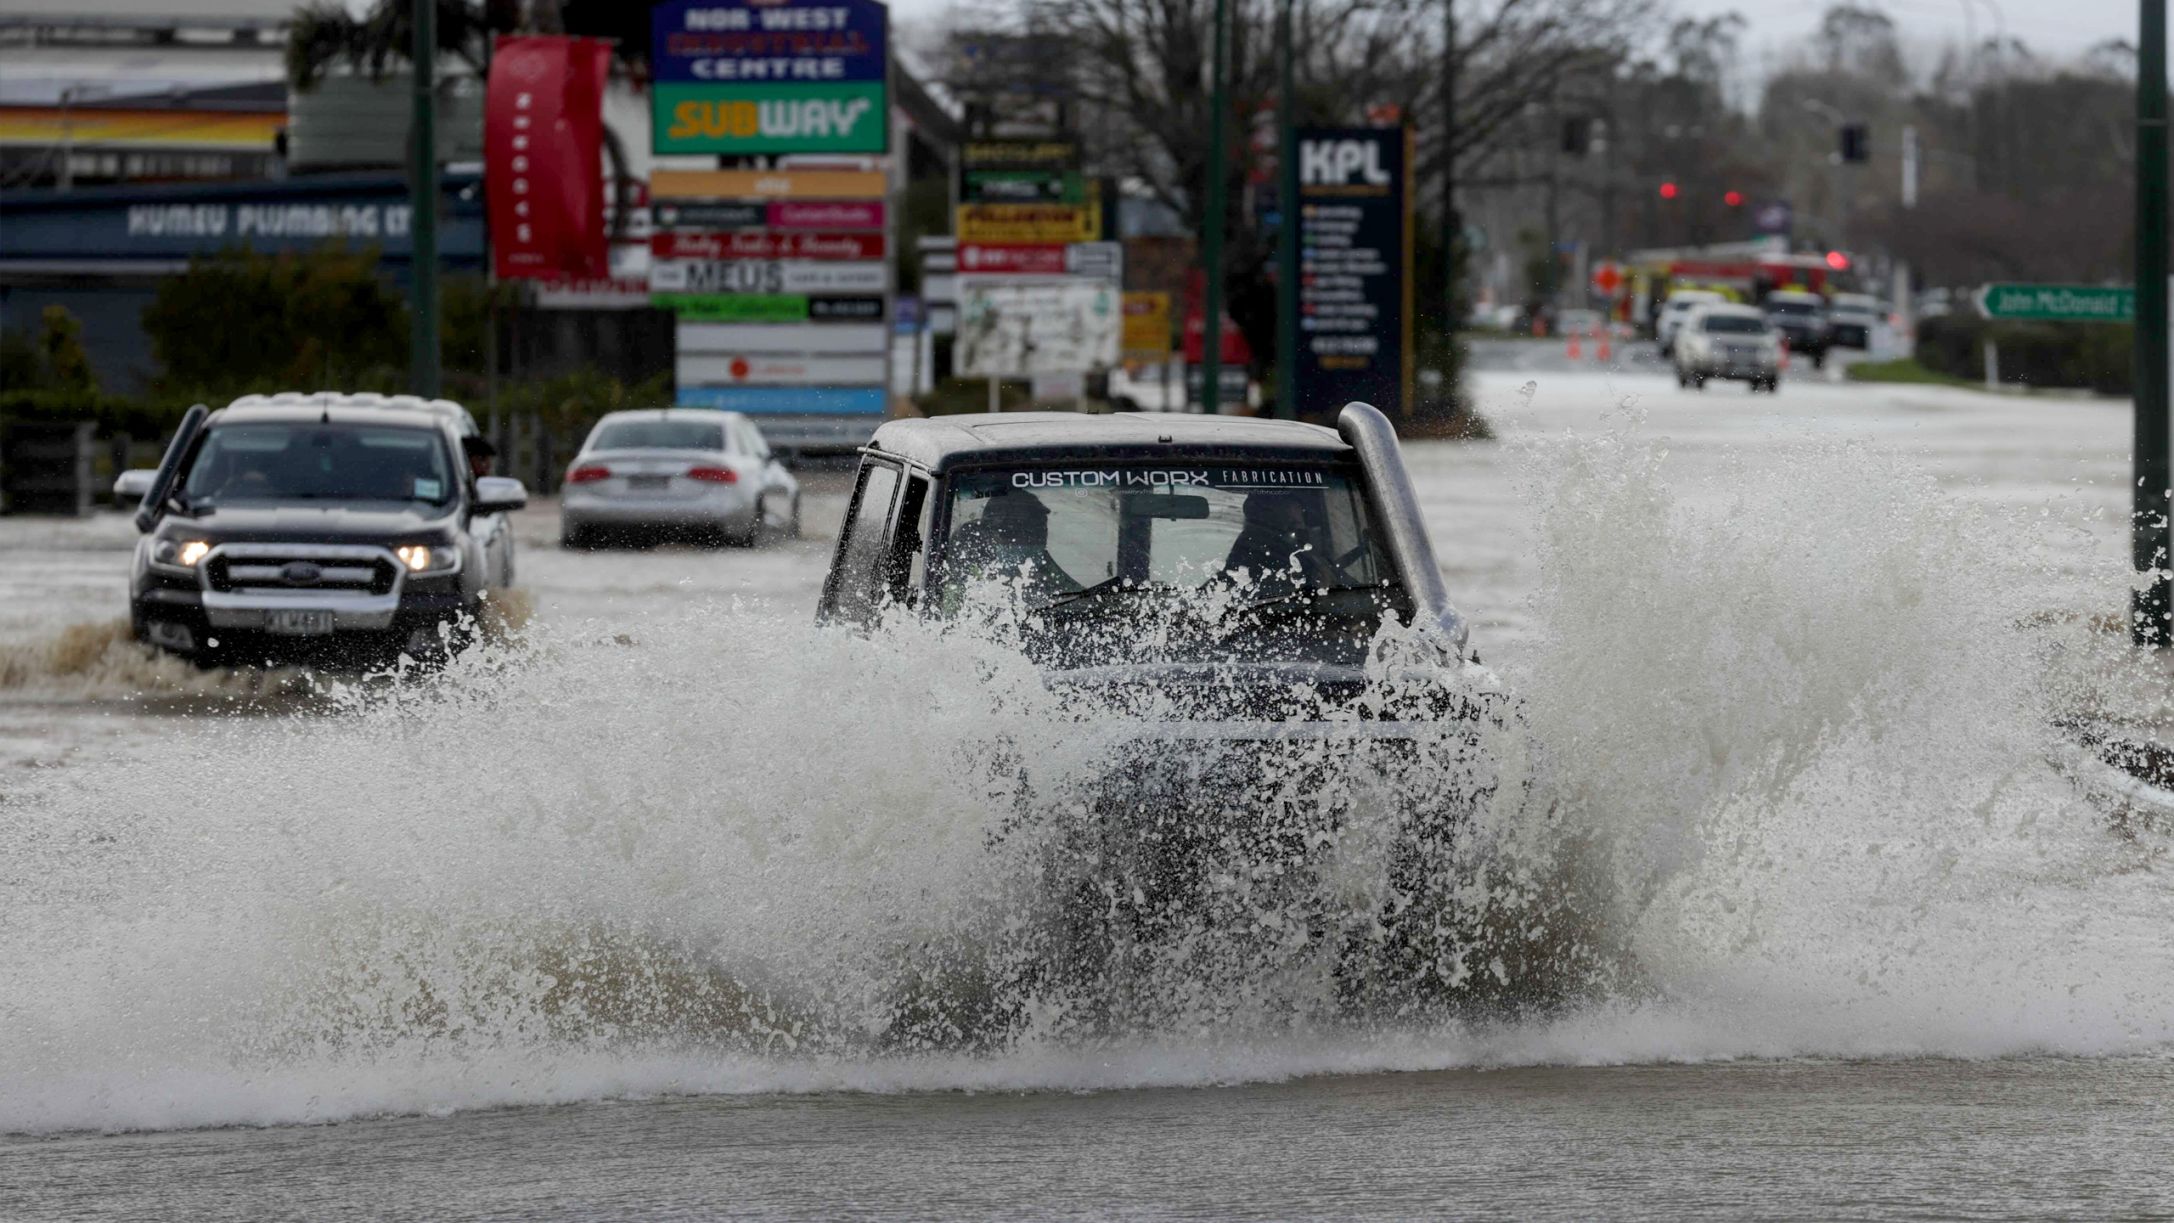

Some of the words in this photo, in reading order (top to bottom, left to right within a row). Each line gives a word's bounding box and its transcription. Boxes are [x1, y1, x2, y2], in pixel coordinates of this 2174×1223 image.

[691, 58, 845, 79] CENTRE
[668, 98, 870, 139] SUBWAY
[1301, 139, 1391, 185] KPL
[237, 204, 379, 236] PLUMBING
[686, 262, 783, 292] MEUS
[1012, 471, 1120, 487] CUSTOM
[1127, 471, 1209, 485] WORX
[1222, 470, 1323, 484] FABRICATION
